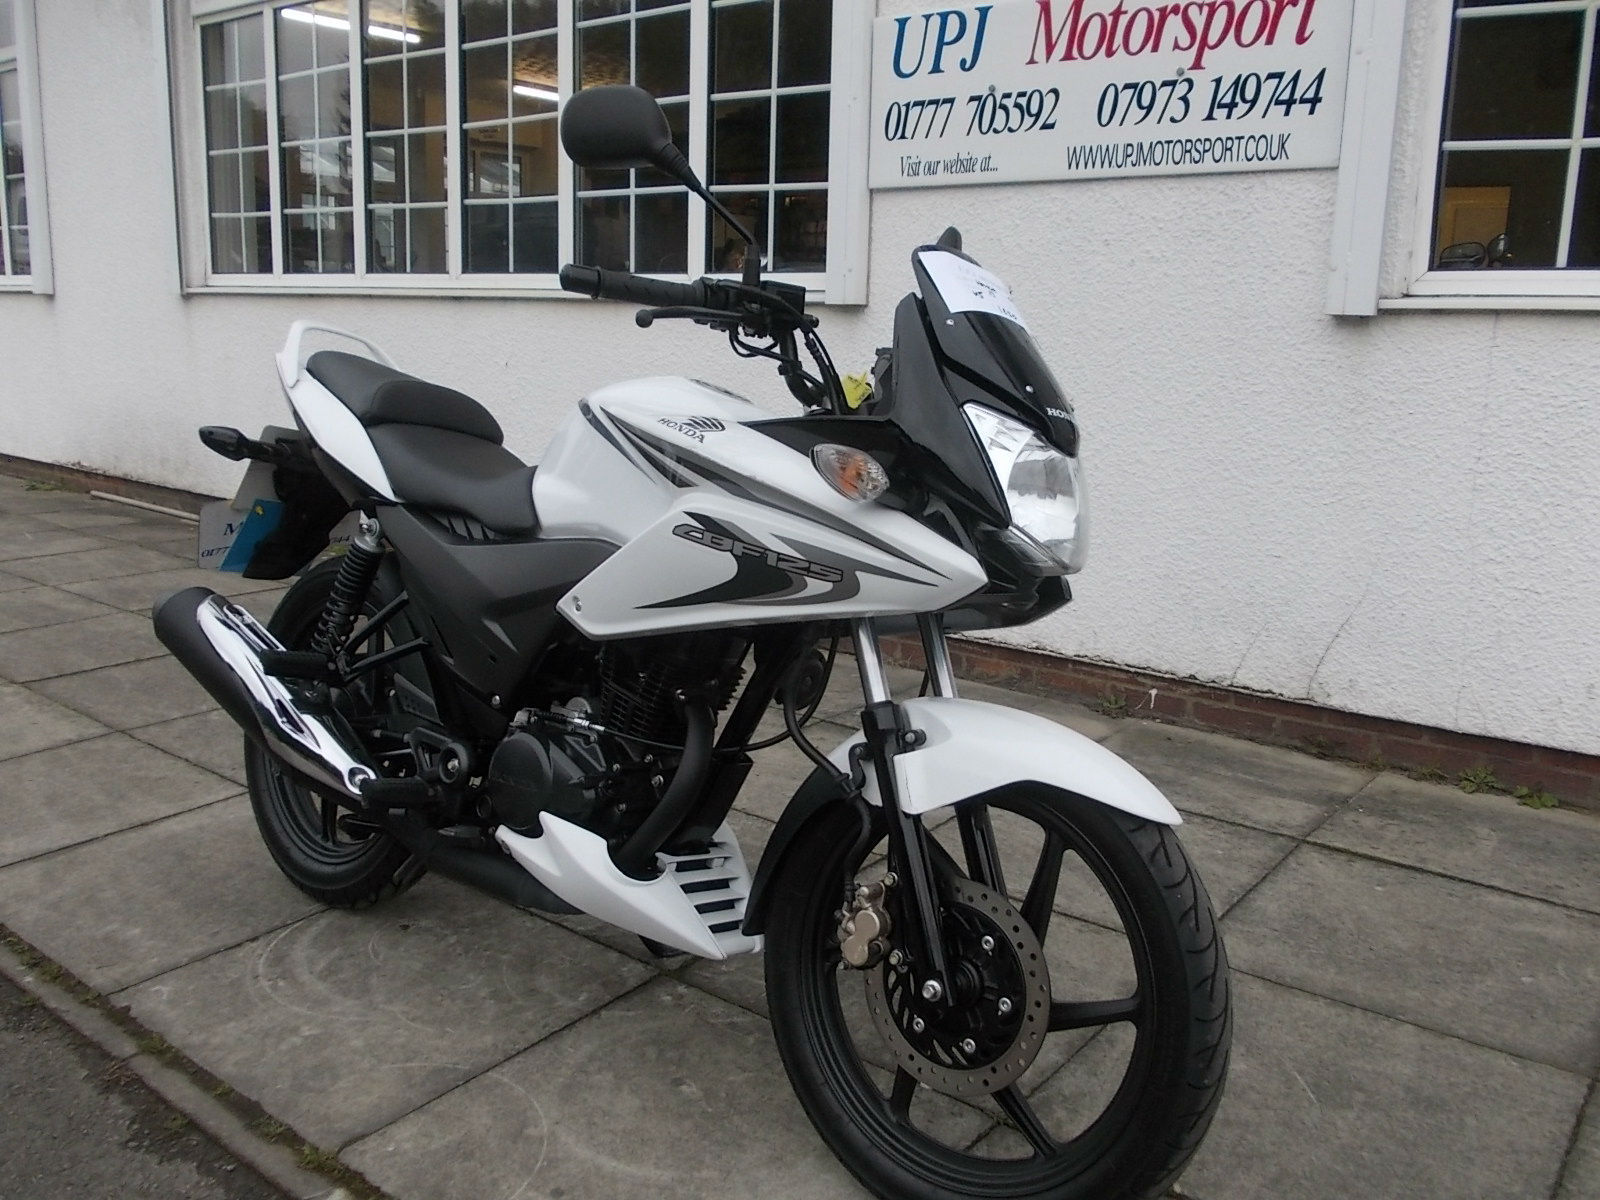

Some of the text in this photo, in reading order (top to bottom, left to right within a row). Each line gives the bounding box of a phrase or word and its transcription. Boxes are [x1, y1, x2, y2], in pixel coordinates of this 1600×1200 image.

[892, 0, 1316, 78] UPJ Motorsport
[885, 68, 1327, 141] 01777 705592 07973 149744
[900, 152, 998, 177] Visit our website at...
[1066, 133, 1291, 170] WWW.UPJMOTORSPORT.CO.UK
[657, 417, 705, 444] HONDA
[672, 523, 844, 583] CBF125
